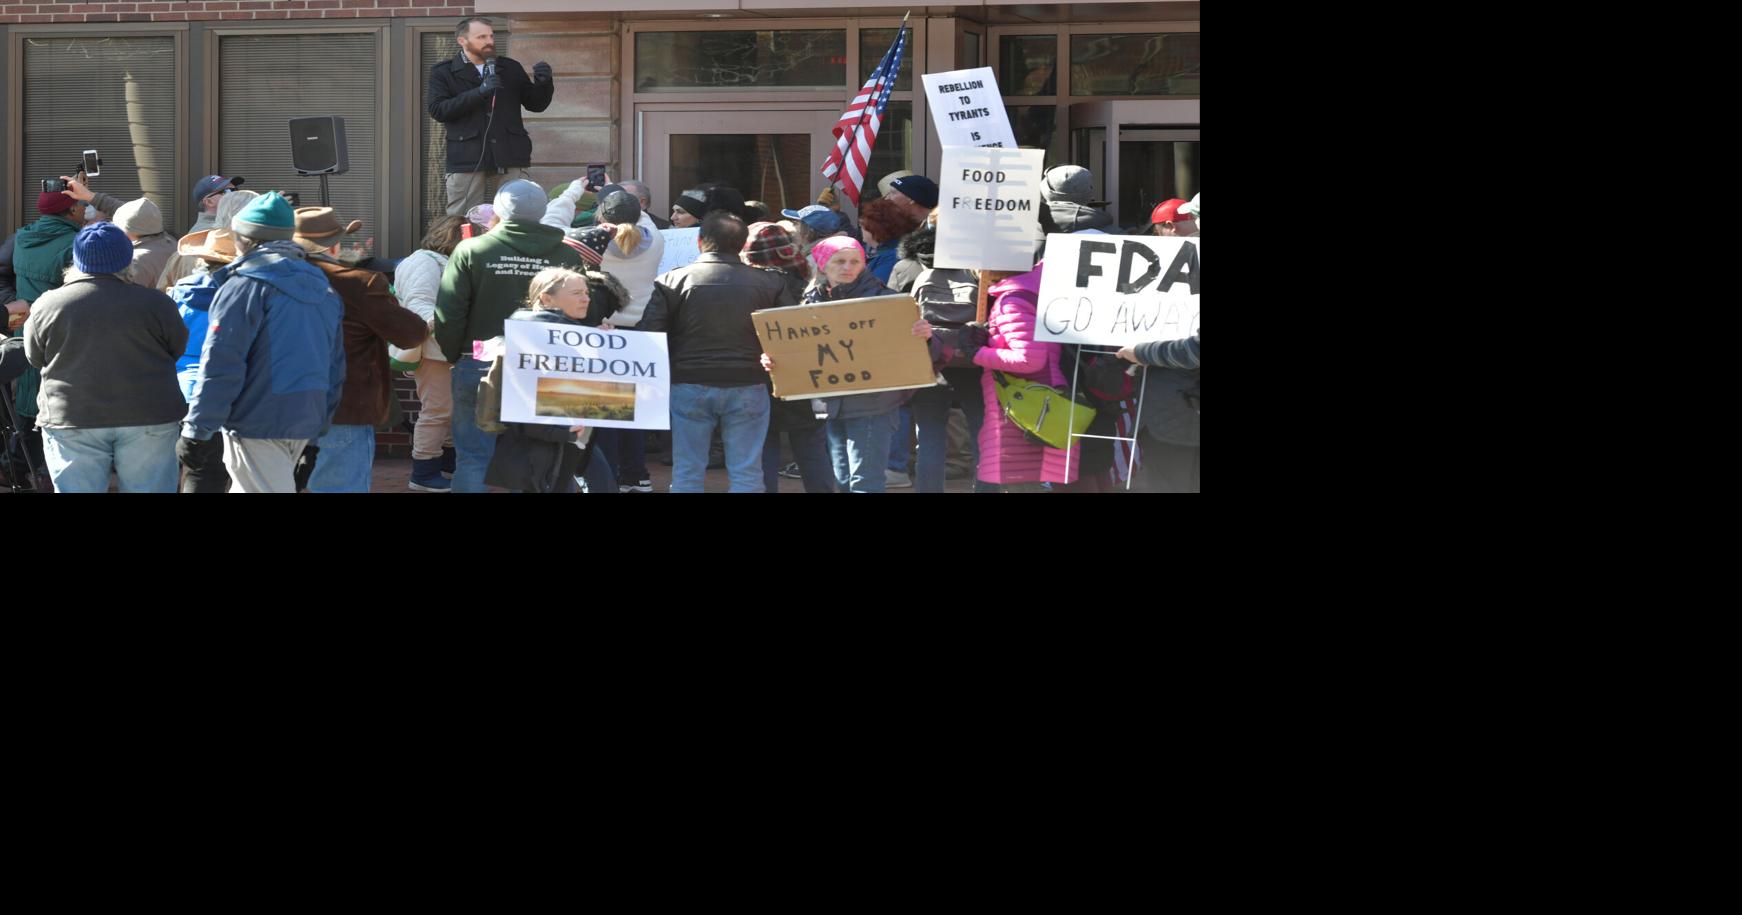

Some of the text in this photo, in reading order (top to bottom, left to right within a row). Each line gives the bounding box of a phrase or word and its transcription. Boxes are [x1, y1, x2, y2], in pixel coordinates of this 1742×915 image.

[938, 80, 984, 94] REBELLION
[958, 95, 971, 105] TO
[948, 107, 990, 121] TYRANTS
[970, 131, 981, 141] IS
[962, 168, 1006, 183] FOOD
[952, 196, 1031, 211] FREEDOM
[486, 262, 519, 270] Legacy
[500, 255, 542, 264] Building
[1075, 239, 1200, 295] FDA
[1043, 296, 1093, 335] GO
[765, 319, 877, 341] HANDS OFF
[547, 328, 627, 350] FOOD
[817, 338, 854, 367] MY
[518, 352, 657, 378] FREEDOM
[808, 369, 872, 389] FOOD
